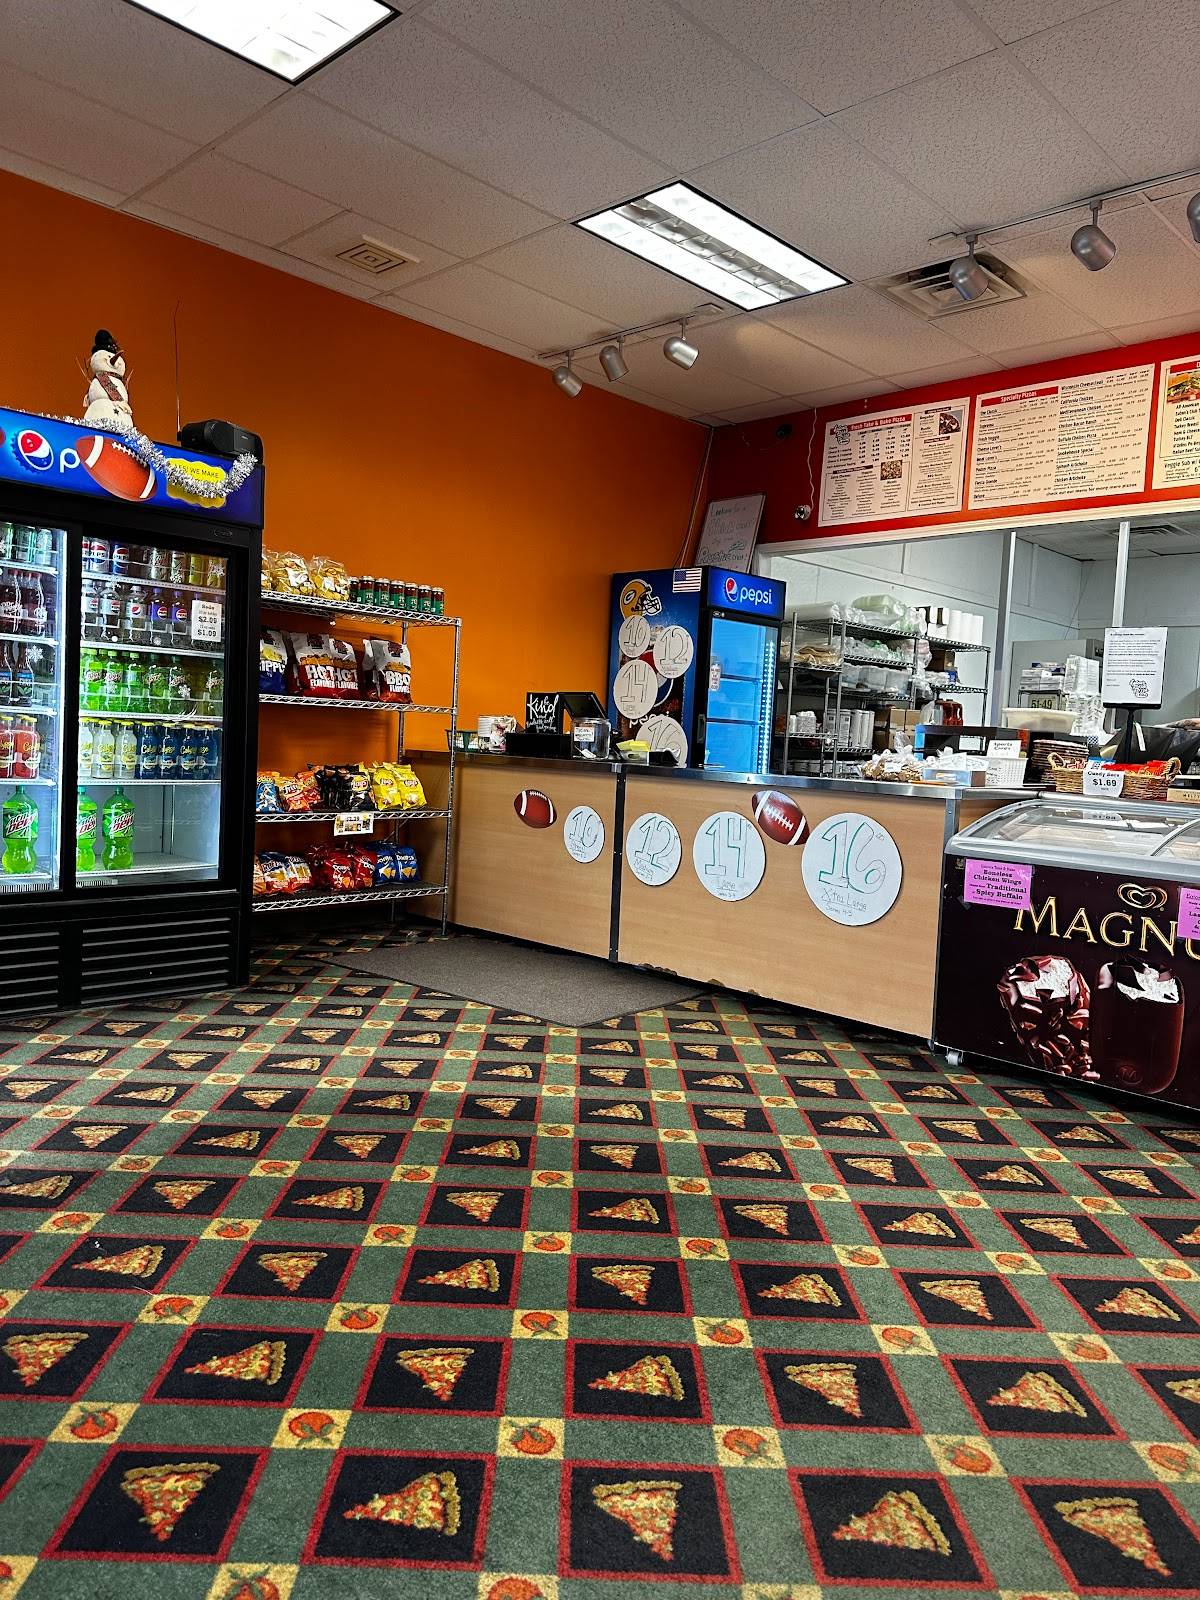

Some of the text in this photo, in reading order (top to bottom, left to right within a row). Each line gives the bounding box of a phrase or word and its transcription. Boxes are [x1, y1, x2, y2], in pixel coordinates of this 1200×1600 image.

[1000, 391, 1037, 402] Specialty Pizzas
[850, 423, 863, 431] Fresh
[880, 418, 892, 426] Bake
[892, 416, 906, 424] Pizza
[201, 470, 219, 478] MAKE
[740, 586, 772, 606] pepsi
[624, 616, 646, 648] 10
[660, 628, 688, 664] 12
[304, 664, 334, 681] HOT
[334, 668, 358, 682] HOT
[620, 664, 650, 703] 14
[527, 694, 559, 720] Kind
[1092, 778, 1117, 787] $1.69
[569, 810, 600, 848] 10
[634, 816, 676, 873] 12
[704, 816, 748, 878] 14
[818, 820, 886, 894] 16
[973, 874, 1022, 886] Chicken Wings
[983, 869, 1013, 878] Boneless
[976, 888, 1023, 900] Spicy Buffalo
[986, 883, 1027, 894] Traditional
